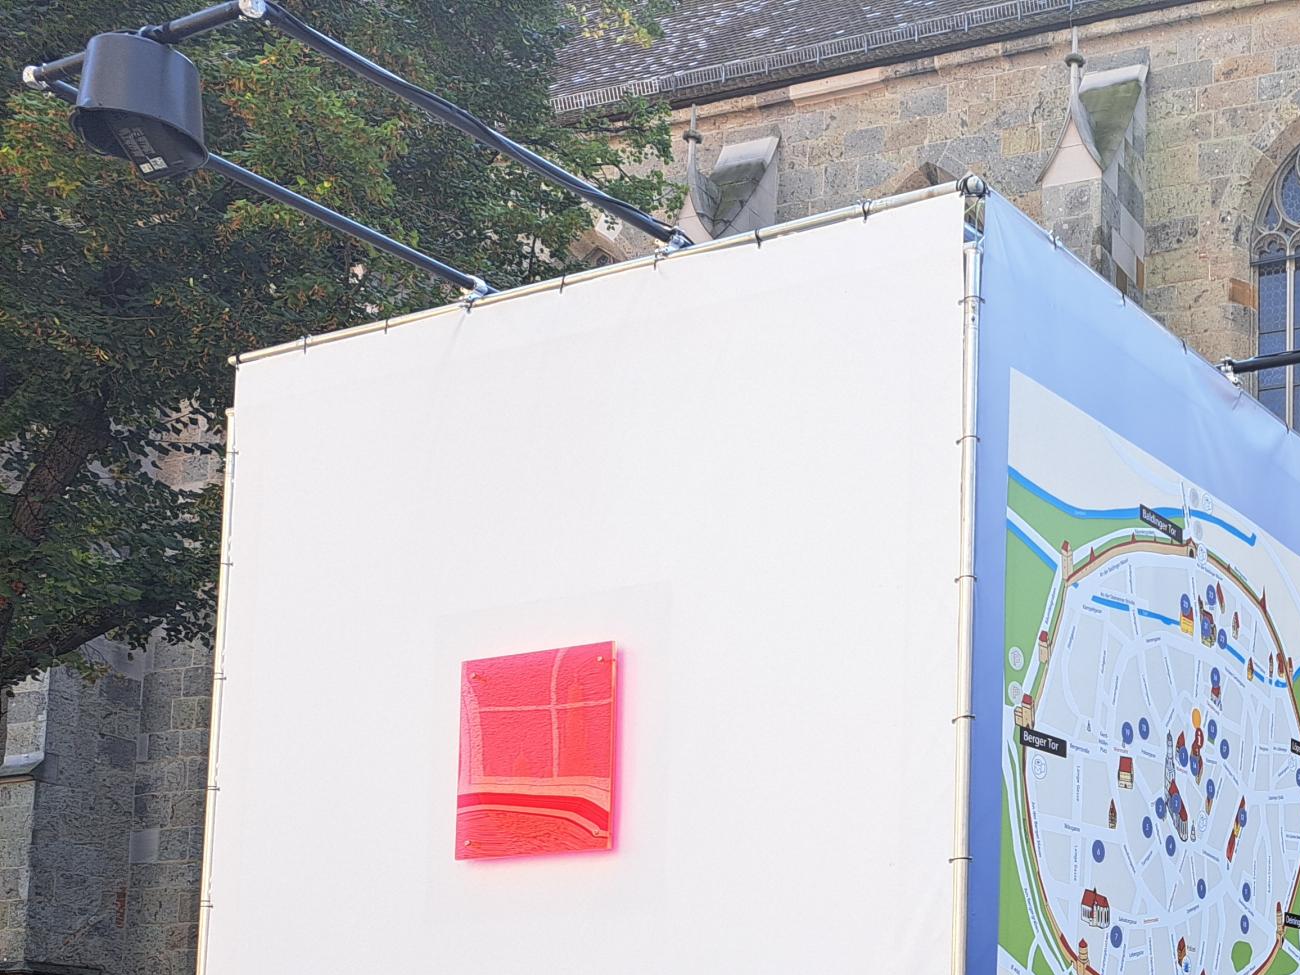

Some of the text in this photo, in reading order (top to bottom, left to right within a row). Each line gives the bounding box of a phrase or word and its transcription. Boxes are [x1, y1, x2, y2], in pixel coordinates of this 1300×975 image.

[1142, 509, 1168, 532] Baldinger
[1023, 731, 1059, 750] Berger Tor
